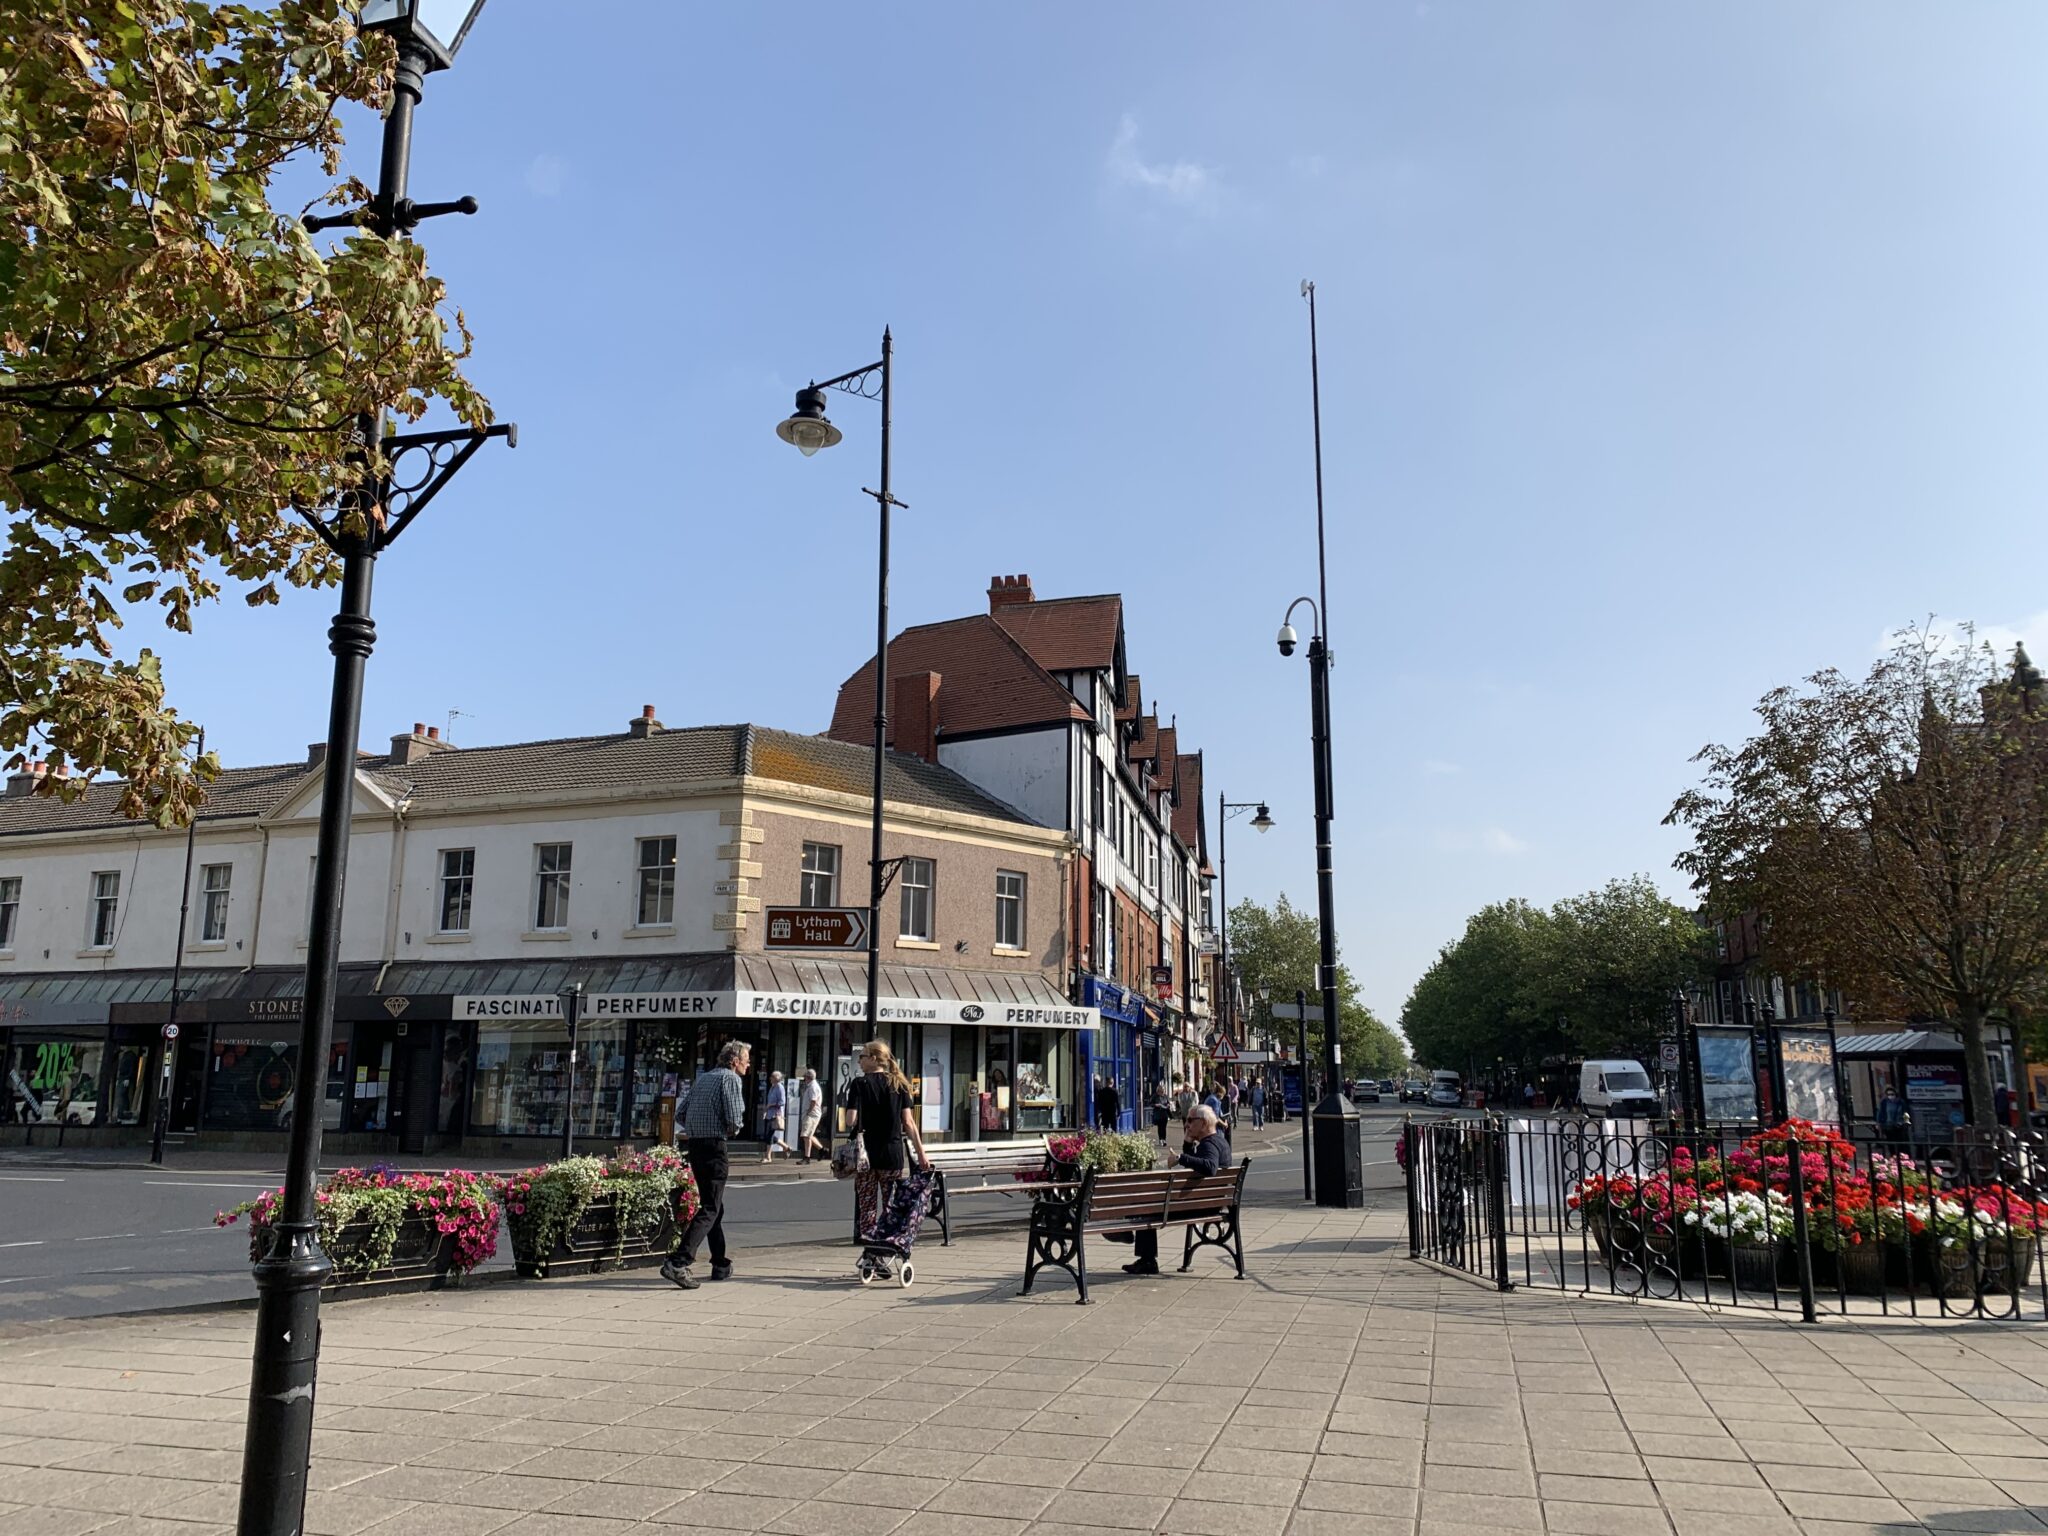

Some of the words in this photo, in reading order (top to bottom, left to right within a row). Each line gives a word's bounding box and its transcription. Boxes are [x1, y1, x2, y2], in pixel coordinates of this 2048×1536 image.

[795, 916, 841, 929] Lytham
[804, 929, 832, 941] Hall
[467, 999, 588, 1015] FASCINATI
[597, 997, 718, 1014] PERFUMERY
[880, 1008, 894, 1018] OF
[896, 1008, 937, 1020] LYTHAM
[1006, 1008, 1090, 1025] PERFUMERY
[167, 1027, 178, 1035] 20
[31, 1041, 74, 1089] 20%
[1906, 1064, 1957, 1072] BLACKPOOL
[1906, 1071, 1933, 1079] SIXTH
